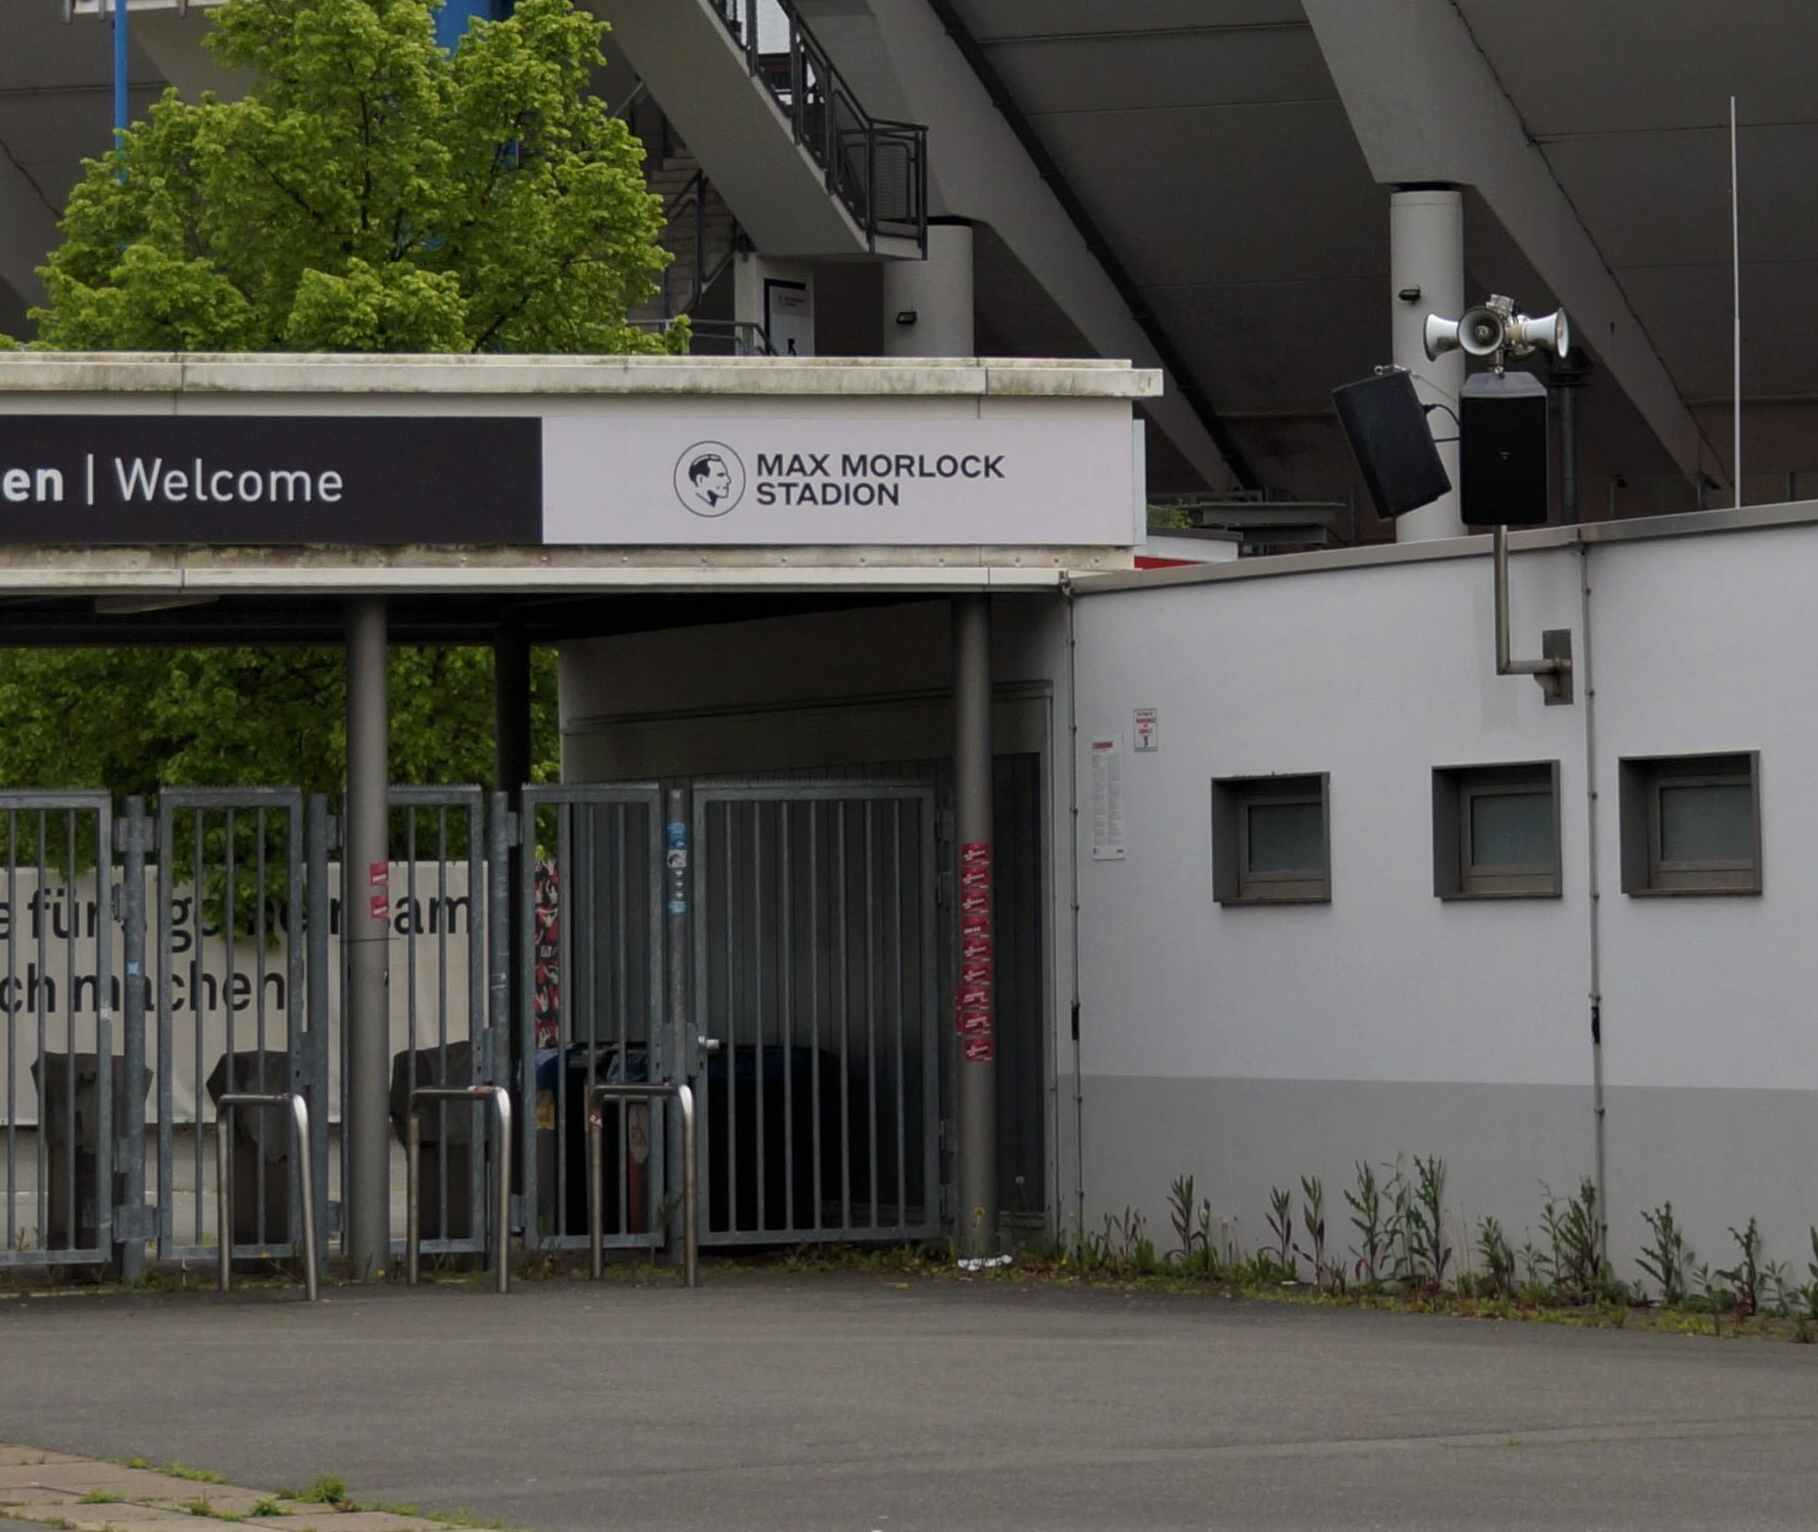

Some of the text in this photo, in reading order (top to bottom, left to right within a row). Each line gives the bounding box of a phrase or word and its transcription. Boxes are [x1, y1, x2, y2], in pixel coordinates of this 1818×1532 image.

[756, 453, 1005, 479] MAX MORLOCK
[114, 457, 343, 502] Welcome
[755, 481, 900, 507] STADION
